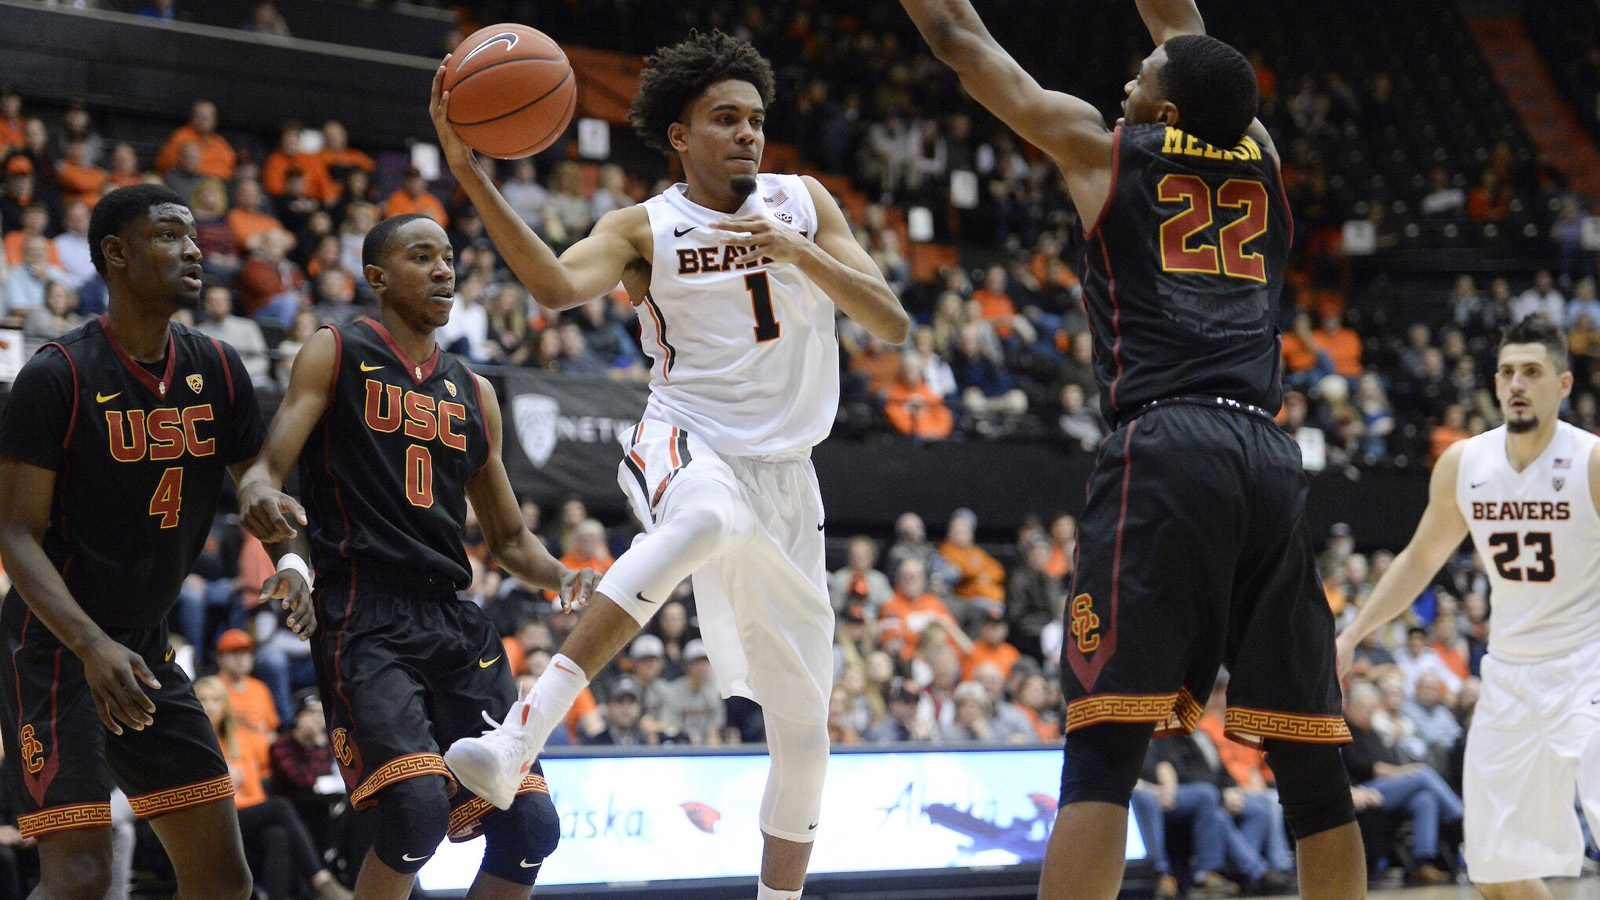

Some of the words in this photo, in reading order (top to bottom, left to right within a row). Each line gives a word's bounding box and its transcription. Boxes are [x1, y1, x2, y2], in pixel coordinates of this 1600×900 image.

[1157, 173, 1268, 283] 22
[743, 270, 781, 343] 1
[105, 403, 216, 463] USC
[364, 378, 467, 452] USC
[149, 466, 184, 529] 4
[405, 443, 434, 509] 0
[1471, 501, 1571, 521] BEAVERS
[1487, 531, 1557, 583] 23
